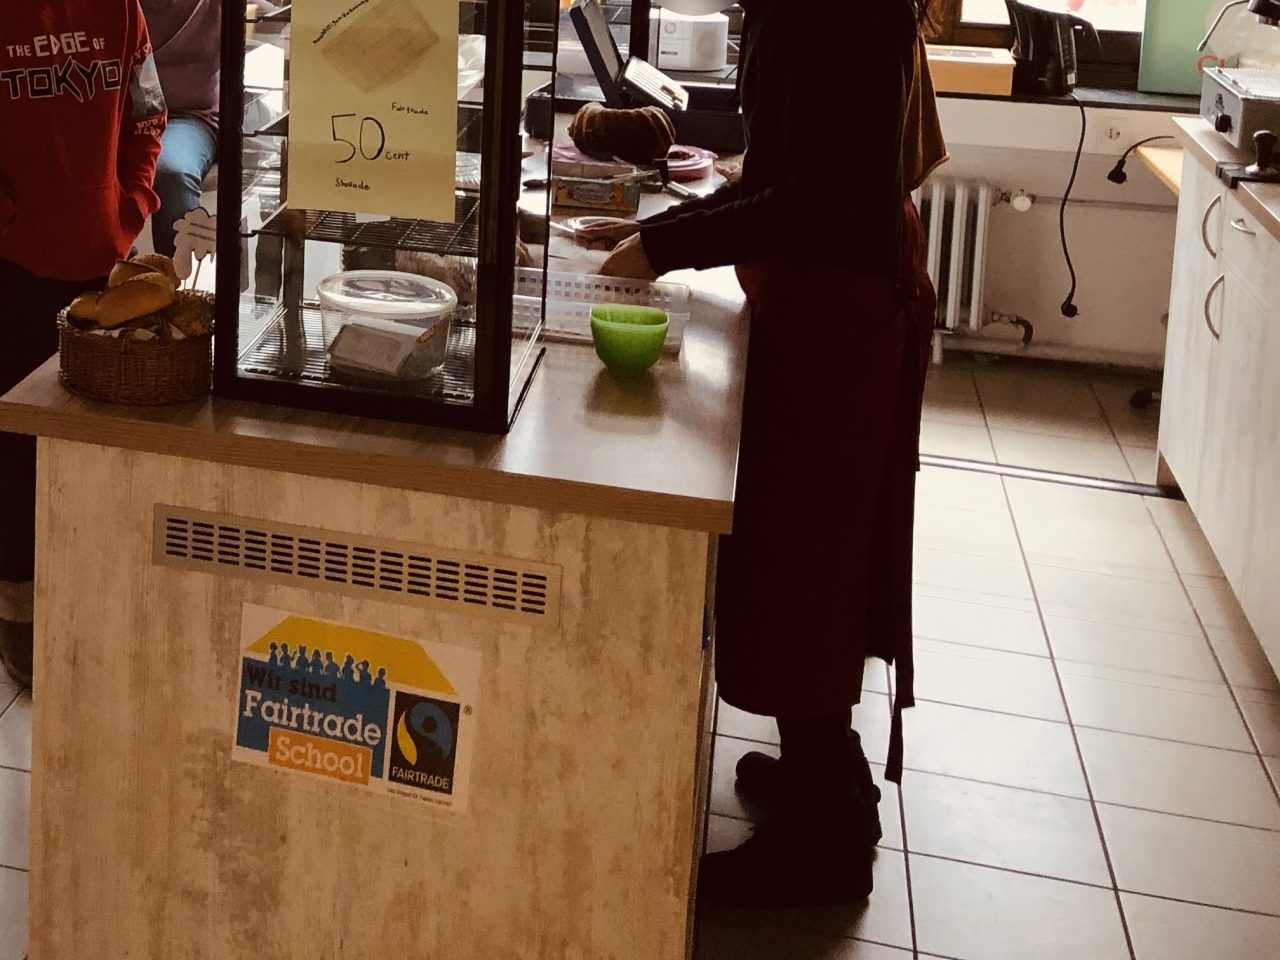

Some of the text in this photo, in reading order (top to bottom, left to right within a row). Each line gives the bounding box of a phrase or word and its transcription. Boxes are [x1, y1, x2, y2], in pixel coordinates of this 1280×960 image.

[6, 31, 107, 59] THE EDGE OF
[0, 55, 123, 104] TOKYO
[331, 113, 386, 164] 50
[247, 664, 338, 703] Wir sind
[242, 689, 383, 747] Fairtrade
[274, 735, 365, 778] School
[391, 765, 451, 790] FAIRTRADE
